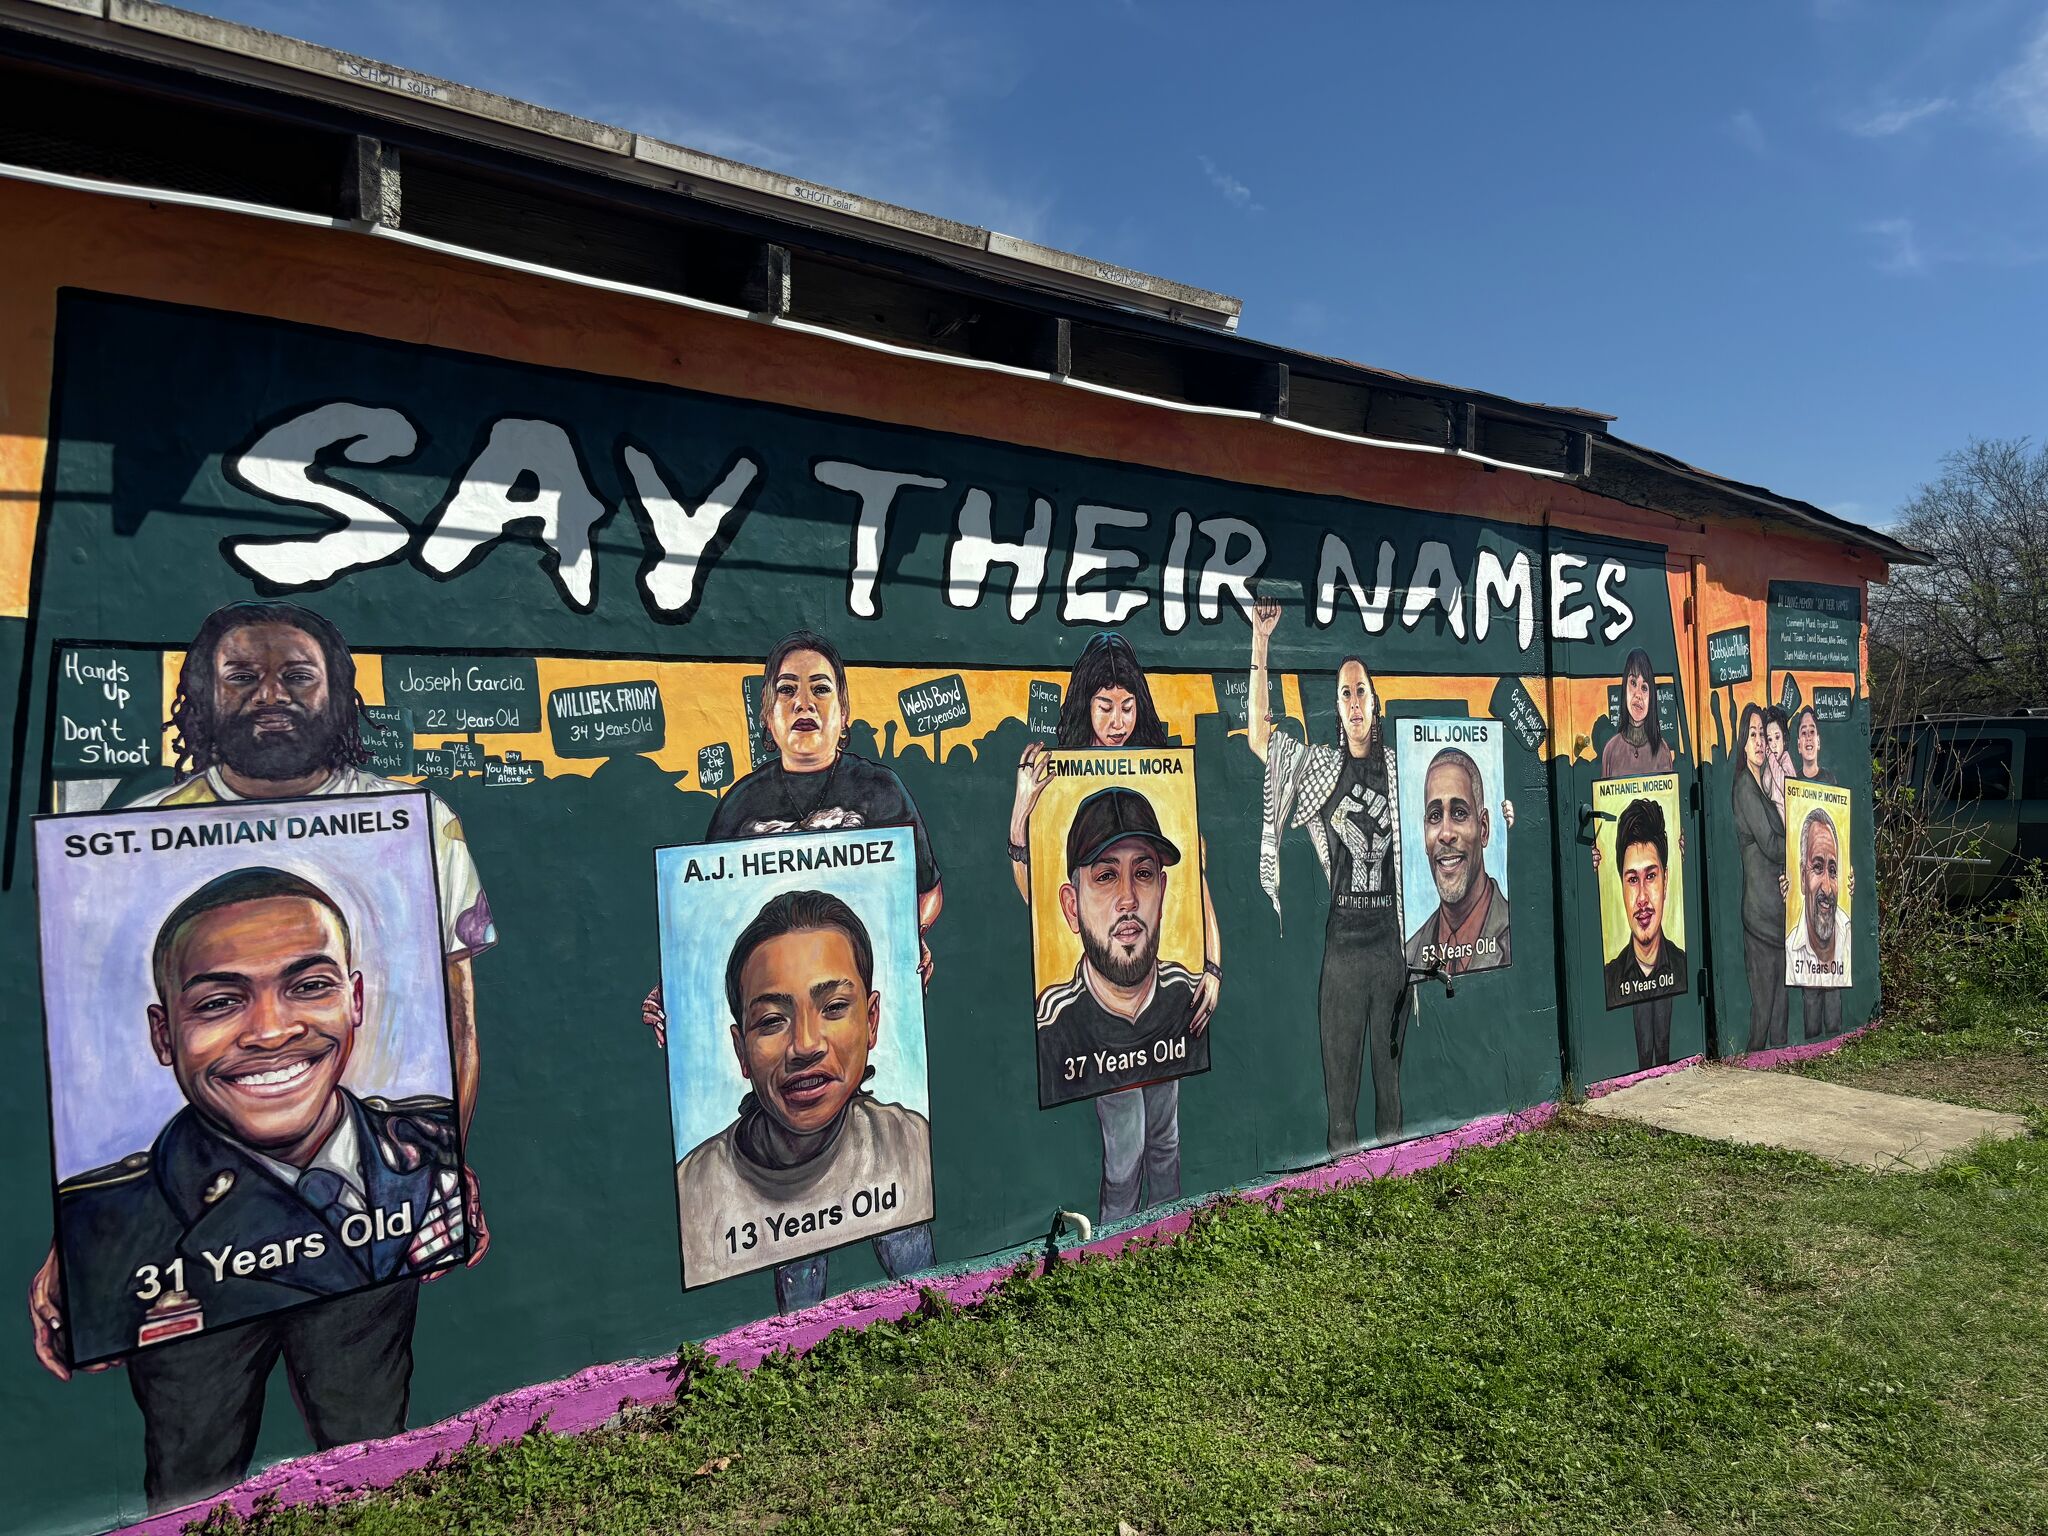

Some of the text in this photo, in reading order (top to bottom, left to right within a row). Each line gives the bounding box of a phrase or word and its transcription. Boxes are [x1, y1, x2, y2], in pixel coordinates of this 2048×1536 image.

[407, 80, 436, 97] solar
[794, 186, 853, 211] SCHOTT solar
[230, 400, 1636, 651] SAY THEIR NAMES
[65, 651, 130, 686] Hands
[400, 666, 526, 694] Joseph Garcia
[1225, 679, 1248, 696] Jesus
[103, 683, 131, 710] Up
[618, 686, 658, 711] FRIDAY
[900, 679, 962, 717] Webb Boyd
[1030, 683, 1058, 704] Silence
[744, 679, 756, 731] HEAR
[1040, 704, 1048, 714] is
[369, 709, 401, 721] Stand
[426, 708, 520, 730] 22 Years Old
[62, 715, 127, 743] Don't
[570, 716, 653, 742] 34 Years Old
[917, 716, 933, 734] 27
[1029, 718, 1057, 735] Violence
[1413, 724, 1488, 743] BILL JONES
[362, 734, 404, 749] What is
[454, 743, 471, 752] YES
[80, 739, 150, 766] Shoot
[372, 753, 402, 769] Right
[426, 751, 441, 763] No
[460, 752, 475, 761] WE
[417, 763, 450, 777] Kings
[456, 759, 477, 767] CAN
[503, 765, 517, 775] ARE
[707, 757, 726, 768] the
[1047, 758, 1184, 776] EMMANUEL MORA
[497, 774, 522, 783] Alone
[1600, 780, 1673, 797] NATHANIEL MORENO
[1787, 786, 1848, 806] SGT. JOHN P. MONTEZ
[64, 808, 411, 859] SGT. DAMIAN DANIELS
[683, 840, 895, 883] A.J. HERNANDEZ
[1337, 894, 1393, 909] SAY THEIR NAMES
[1422, 937, 1496, 963] 53 Years Old
[1795, 960, 1844, 975] 57 Years Old
[1619, 973, 1675, 996] 19 Years Old
[1064, 1035, 1187, 1081] 37 Years Old
[725, 1182, 897, 1254] 13 Years Old
[134, 1202, 412, 1301] 31 Years Old
